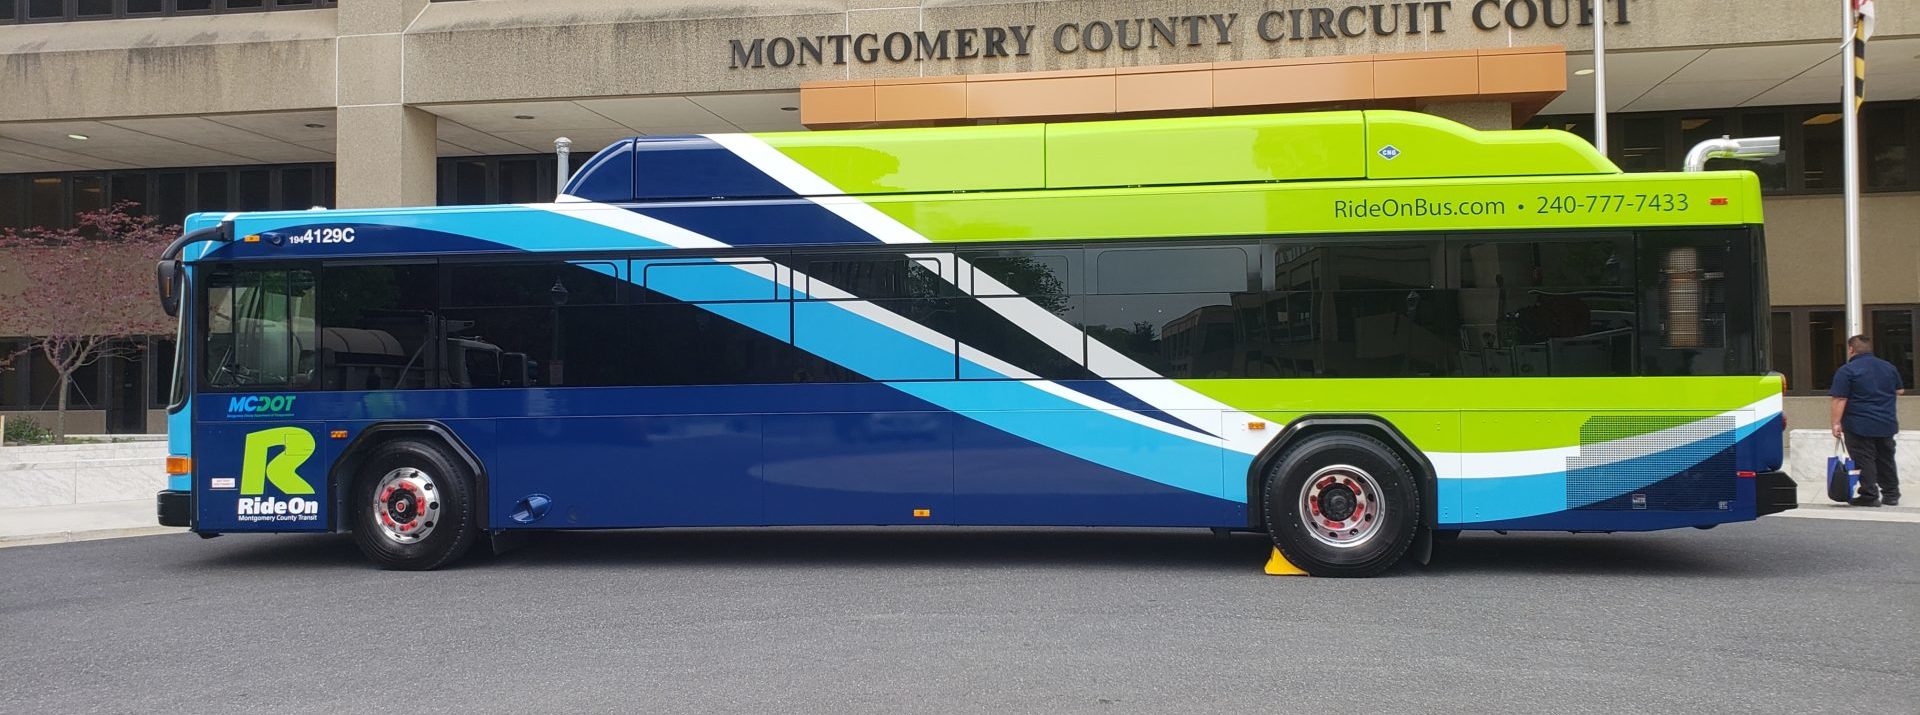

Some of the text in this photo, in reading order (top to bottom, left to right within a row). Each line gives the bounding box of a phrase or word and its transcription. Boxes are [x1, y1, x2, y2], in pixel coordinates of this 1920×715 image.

[728, 25, 1035, 69] MONTGOMERY
[1053, 12, 1238, 54] COUNTY
[1257, 1, 1451, 42] CIRCUIT
[1334, 194, 1689, 218] RideOnBus.com 240-777-7433
[228, 396, 296, 412] MCDOT
